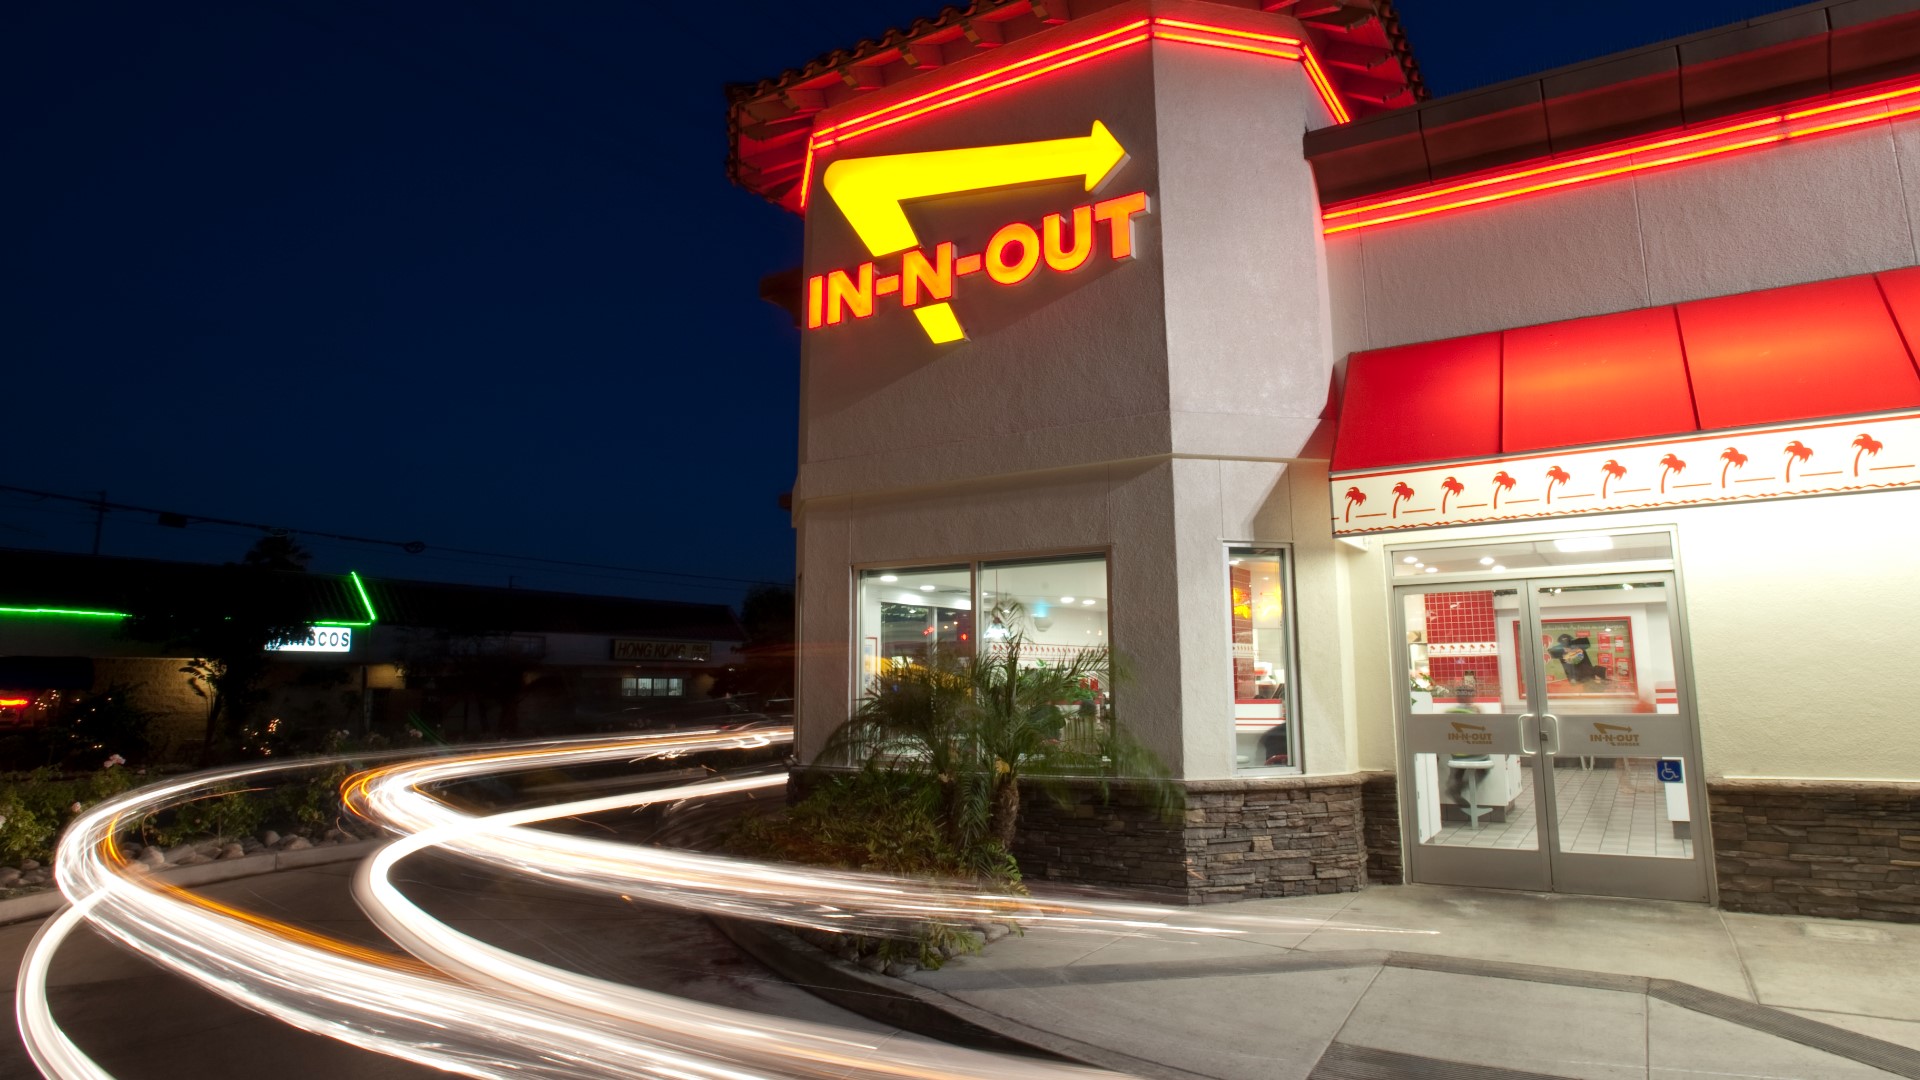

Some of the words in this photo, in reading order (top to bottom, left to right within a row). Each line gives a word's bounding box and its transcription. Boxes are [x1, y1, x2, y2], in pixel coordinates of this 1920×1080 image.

[808, 191, 1150, 329] IN-N-OUT
[618, 642, 652, 657] HONG
[1448, 732, 1492, 741] IN-N-OUT
[1590, 734, 1639, 742] IN-N-OUT
